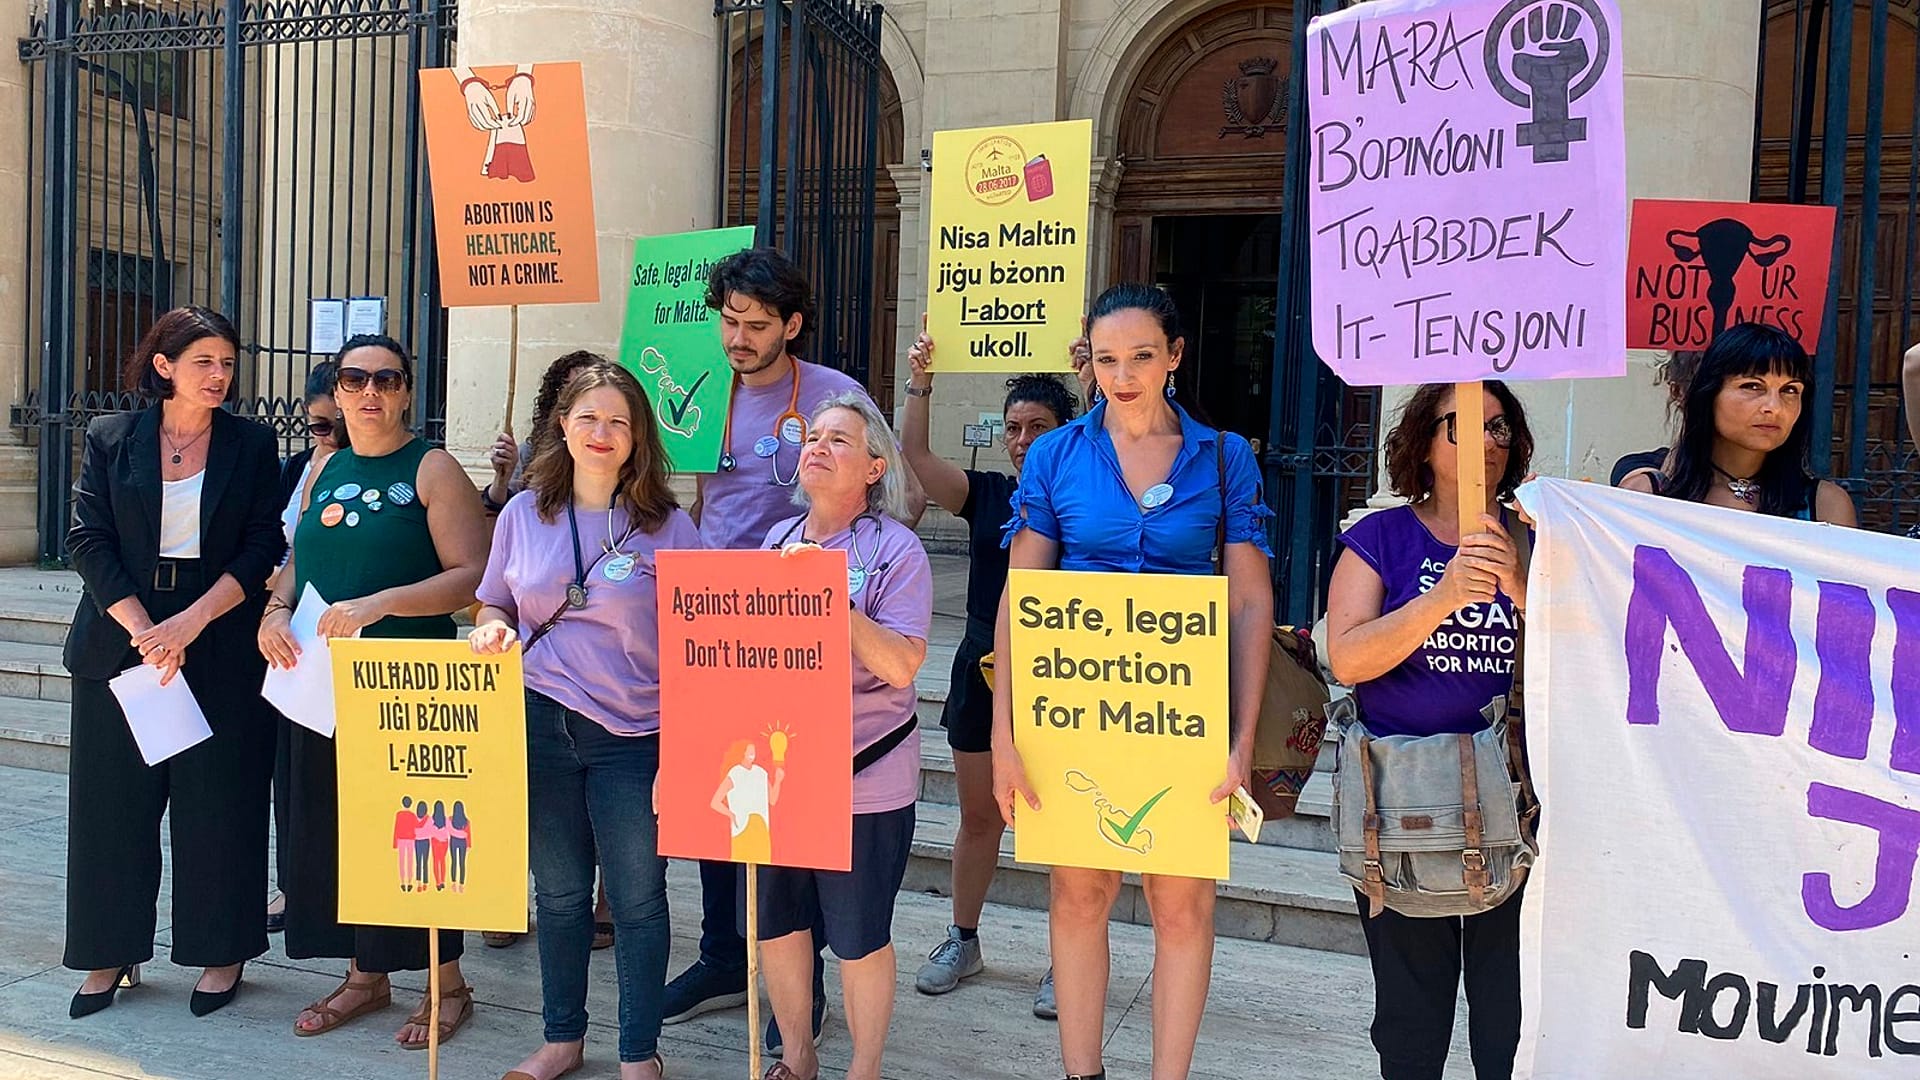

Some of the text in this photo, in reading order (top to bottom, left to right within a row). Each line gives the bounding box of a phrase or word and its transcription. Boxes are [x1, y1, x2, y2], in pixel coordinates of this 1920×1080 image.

[1320, 11, 1484, 104] MARA
[982, 165, 1011, 179] Malta
[465, 200, 553, 225] ABORTION IS
[466, 232, 562, 256] HEALTHCARE,
[940, 220, 1076, 250] Nisa Maltin
[1317, 206, 1595, 279] TQABBDEK
[469, 262, 563, 286] NOT A CRIME.
[634, 263, 661, 287] Safe,
[664, 259, 693, 288] legal
[936, 260, 1065, 293] jiġu bżonn
[1636, 264, 1709, 299] NOT
[654, 300, 709, 324] for Malta.
[961, 296, 1046, 323] l-abort
[970, 331, 1033, 357] ukoll.
[1394, 292, 1586, 373] TENSJONI
[672, 586, 833, 621] Against abortion?
[1019, 596, 1217, 645] Safe, legal
[685, 638, 823, 670] Don't have one!
[1422, 632, 1518, 654] ABORTIO
[353, 661, 500, 691] KULĦADD JISTA'
[1032, 648, 1191, 686] abortion
[1426, 655, 1516, 674] FOR MALT
[379, 696, 479, 732] JIĠI BŻONN
[1032, 696, 1205, 738] for Malta
[389, 743, 473, 776] L-ABORT.
